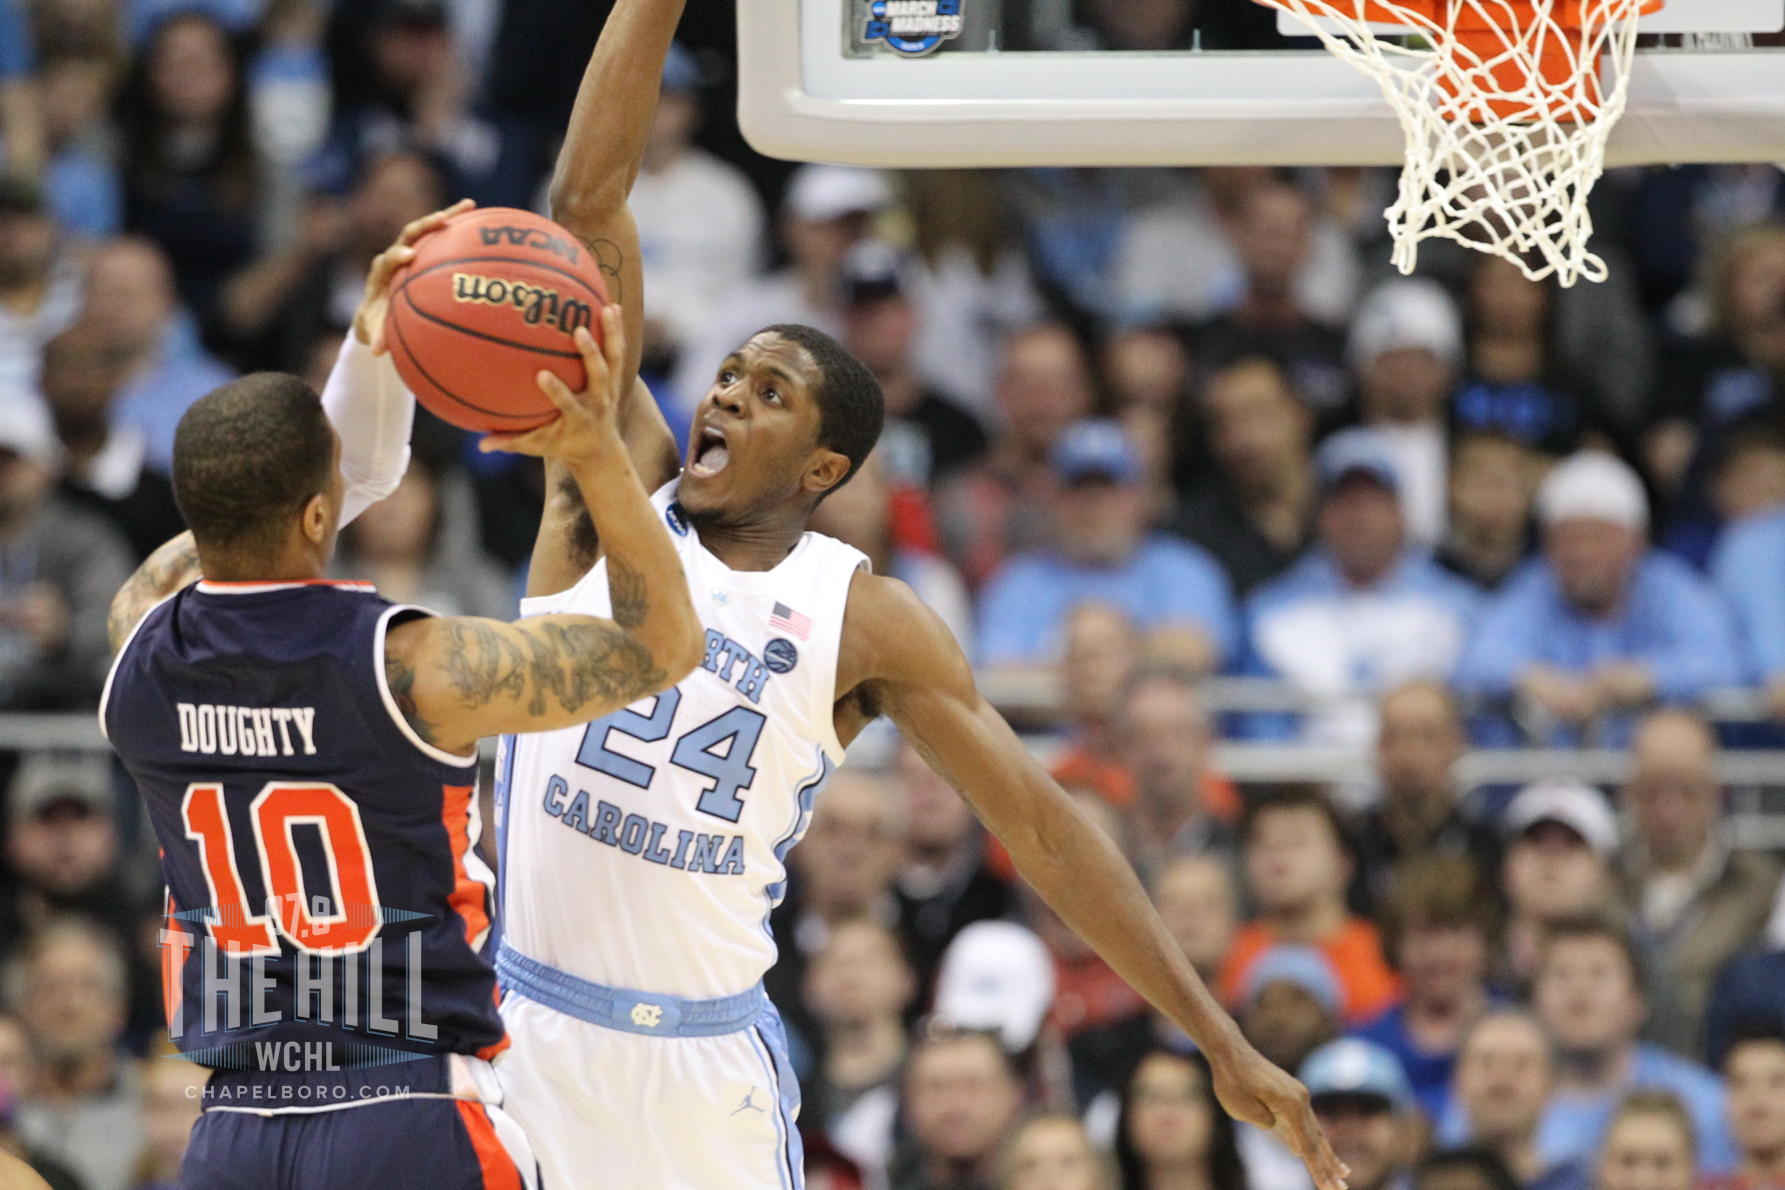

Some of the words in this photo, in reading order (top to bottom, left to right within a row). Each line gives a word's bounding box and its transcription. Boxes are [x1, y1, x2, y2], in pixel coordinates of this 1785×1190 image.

[891, 16, 961, 33] MADNESS
[480, 226, 578, 264] NCAA
[453, 273, 592, 336] Wilson
[701, 628, 770, 704] RTH
[177, 702, 317, 756] DOUGHTY
[575, 685, 767, 823] 24
[543, 774, 746, 875] CAROLINA
[181, 781, 384, 958] 10
